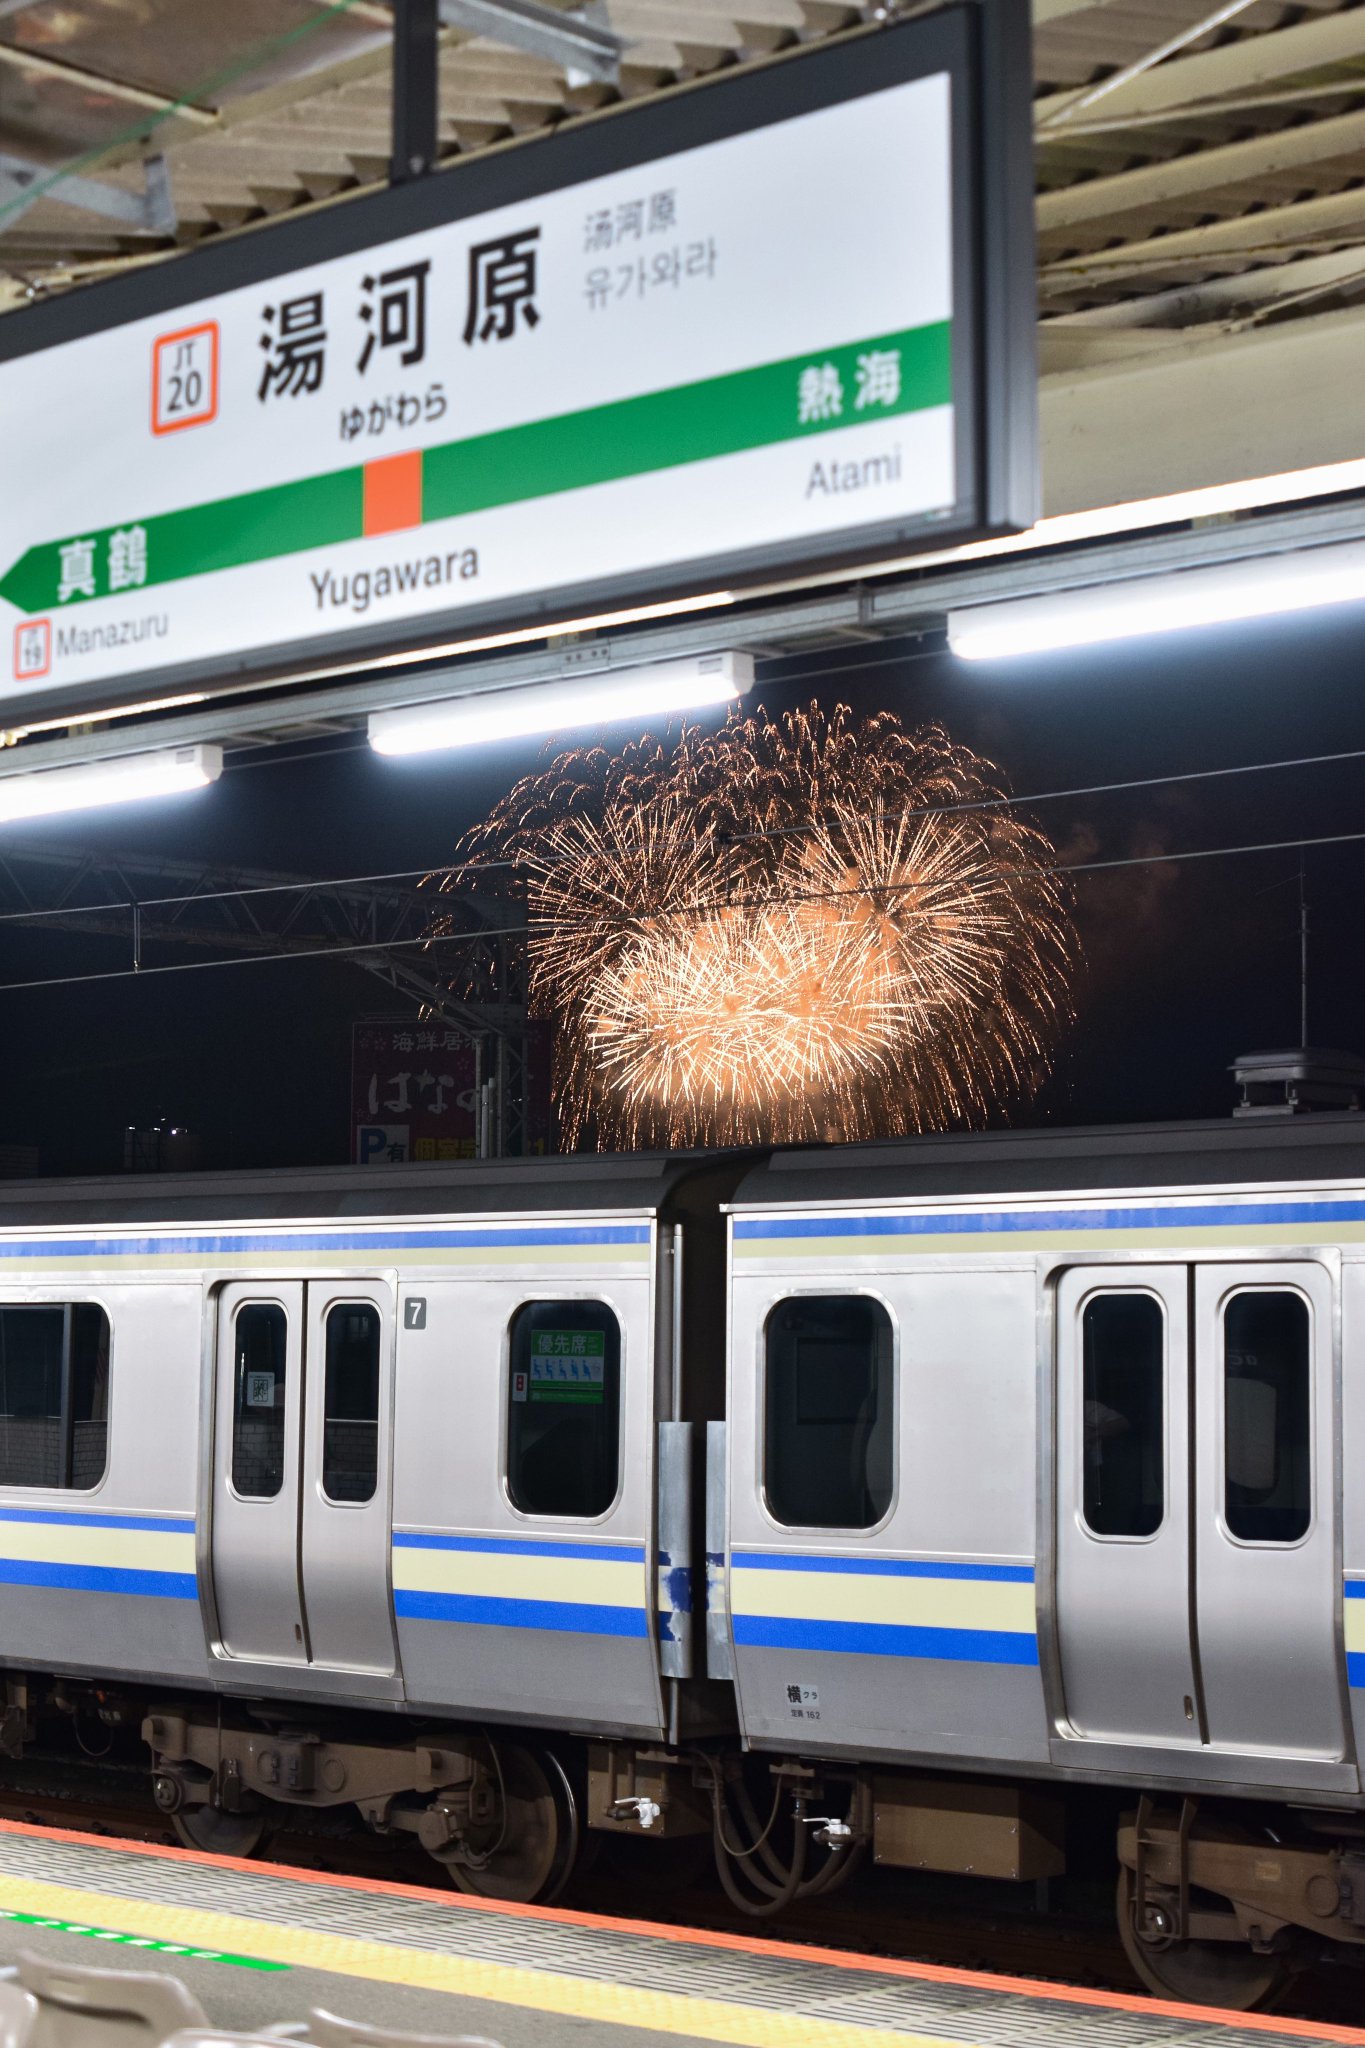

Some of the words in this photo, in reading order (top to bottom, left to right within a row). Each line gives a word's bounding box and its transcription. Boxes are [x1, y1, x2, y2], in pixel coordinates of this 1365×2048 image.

[584, 236, 718, 310] 유가와라
[257, 226, 541, 404] 湯河原
[174, 340, 197, 372] JT
[167, 370, 202, 413] 20
[798, 350, 901, 424] 熱海
[340, 383, 447, 442] ゆがわら
[805, 444, 903, 499] Atami
[57, 524, 148, 603] 真鶴
[308, 547, 481, 613] Yugawara
[24, 644, 42, 666] 19
[57, 614, 170, 658] Manazuru
[410, 1302, 421, 1325] 7
[538, 1334, 587, 1354] 優先席
[806, 1711, 821, 1720] 162
